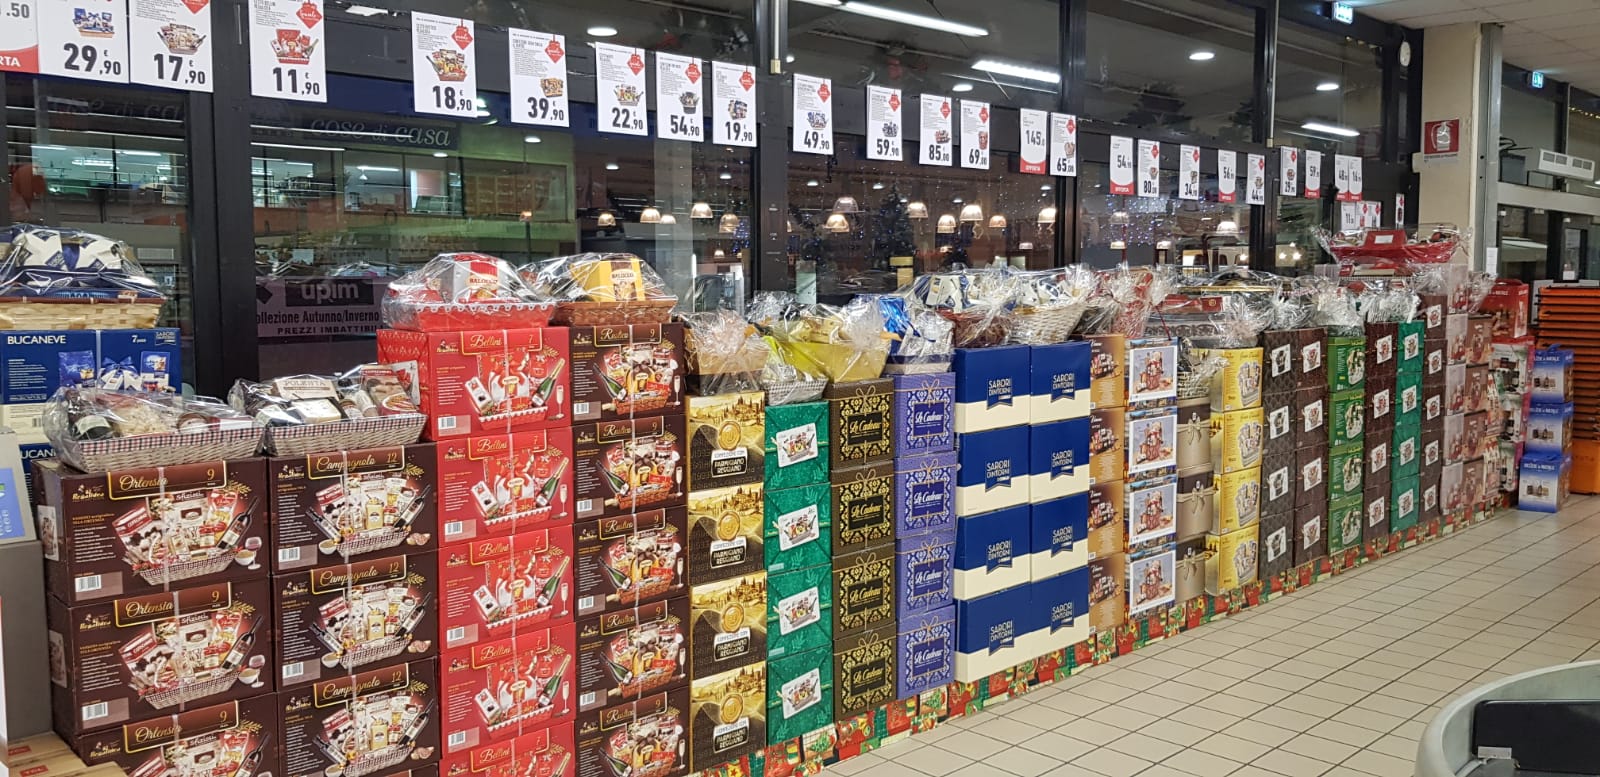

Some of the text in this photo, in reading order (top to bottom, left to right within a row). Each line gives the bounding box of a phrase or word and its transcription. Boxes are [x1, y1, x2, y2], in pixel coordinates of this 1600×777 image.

[0, 3, 30, 19] .50
[396, 126, 450, 146] casa
[301, 283, 359, 304] upim
[8, 336, 66, 345] BUCANEVE
[988, 378, 1011, 388] SAPORI
[1053, 373, 1074, 382] SAPORI
[1052, 450, 1072, 461] SAPORI
[986, 460, 1010, 470] SAPORI
[1053, 526, 1072, 537] SAPORI
[988, 541, 1011, 552] SAPORI
[1052, 602, 1072, 614] SAPORI
[990, 621, 1012, 634] SAPORI
